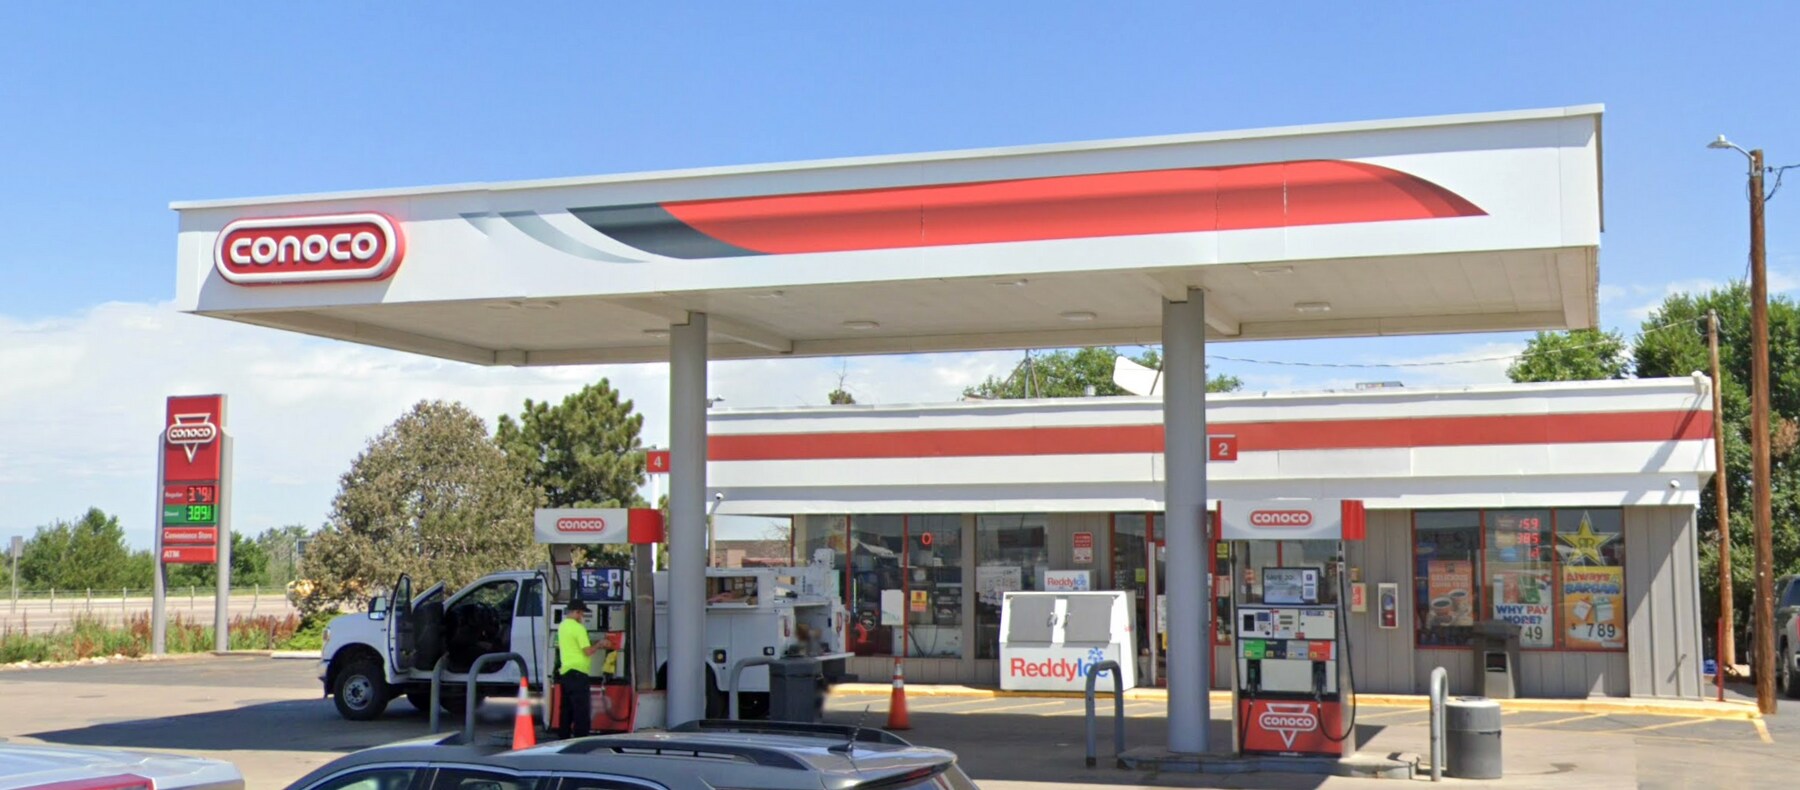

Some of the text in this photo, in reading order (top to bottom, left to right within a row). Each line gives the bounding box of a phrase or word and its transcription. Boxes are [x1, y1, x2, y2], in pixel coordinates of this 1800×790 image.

[1218, 442, 1229, 456] 2
[653, 455, 662, 468] 4
[198, 531, 213, 539] Store
[163, 550, 180, 558] ATM
[1496, 605, 1549, 614] WHY PAY
[1519, 625, 1543, 640] 49
